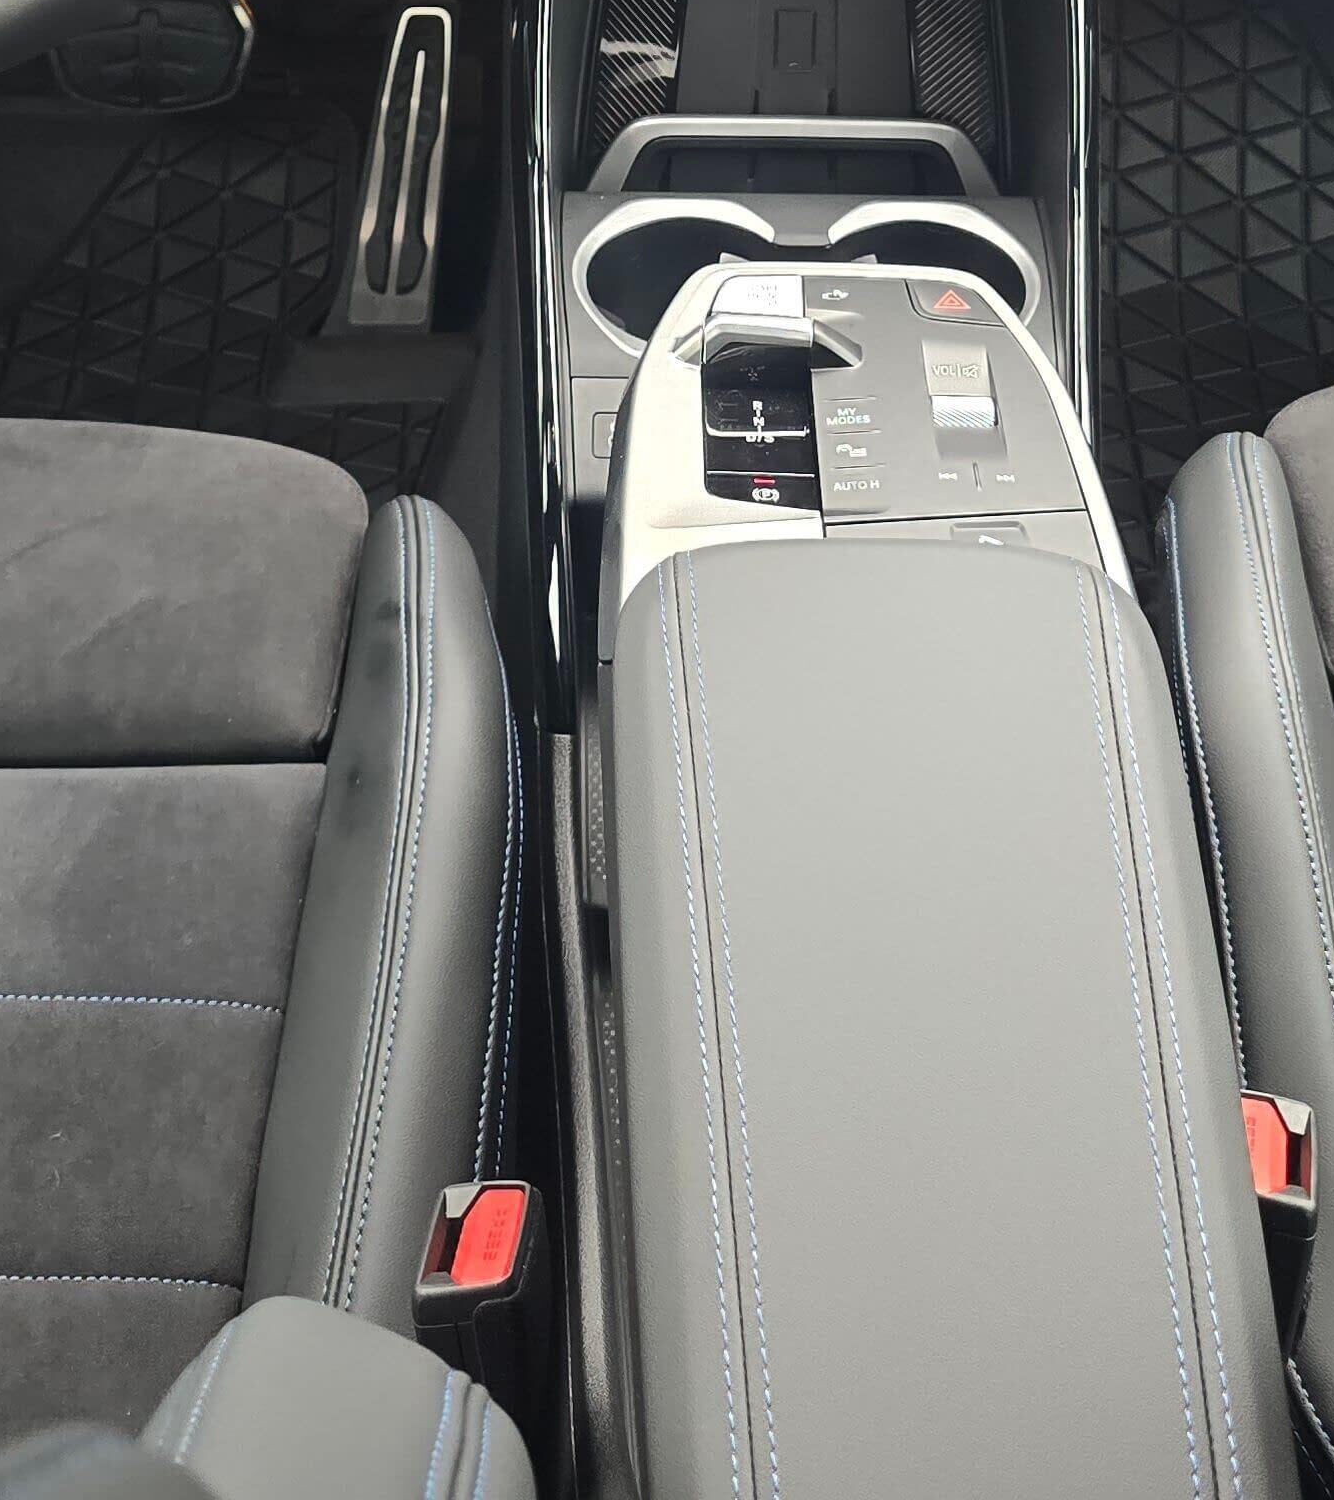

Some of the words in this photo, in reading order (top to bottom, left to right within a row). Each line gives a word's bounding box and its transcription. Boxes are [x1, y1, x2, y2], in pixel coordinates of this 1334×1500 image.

[933, 364, 956, 377] VOL
[837, 407, 857, 417] MY
[752, 416, 765, 427] N
[826, 414, 871, 426] MODES
[833, 480, 868, 492] AUTO
[870, 480, 880, 490] H
